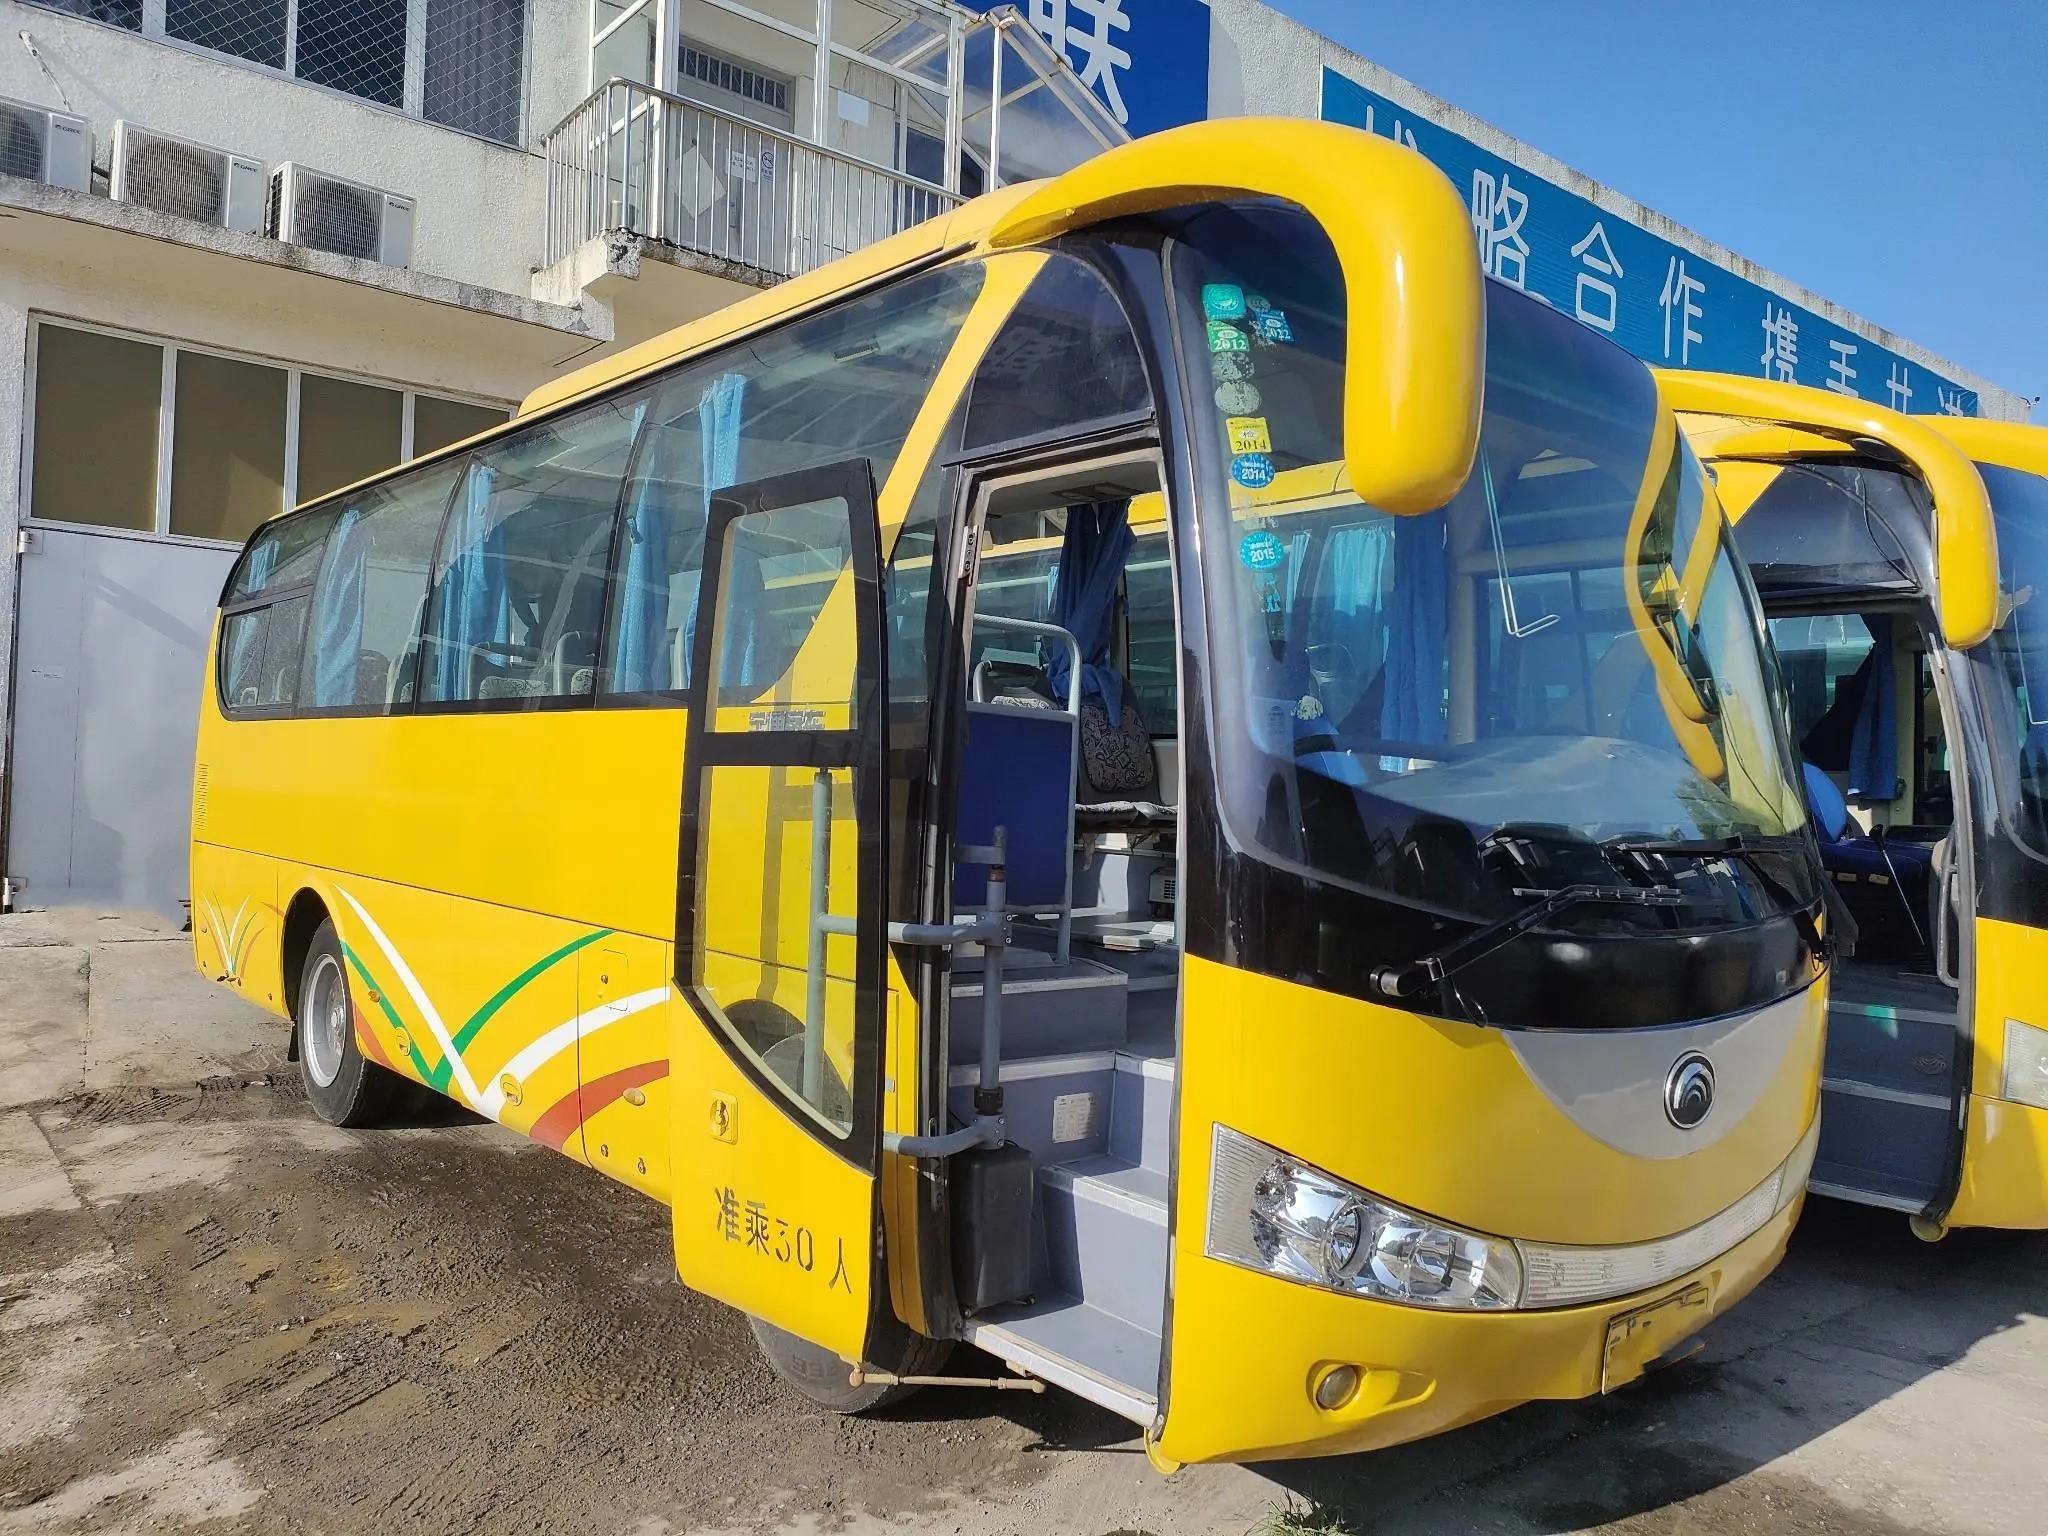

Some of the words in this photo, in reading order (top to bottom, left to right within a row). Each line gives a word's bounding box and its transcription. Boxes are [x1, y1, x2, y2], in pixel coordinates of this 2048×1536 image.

[1366, 105, 1706, 366] 略合作
[1213, 339, 1247, 351] 2012
[1235, 440, 1267, 451] 2014
[1241, 467, 1267, 480] 2014
[1250, 548, 1275, 562] 2015
